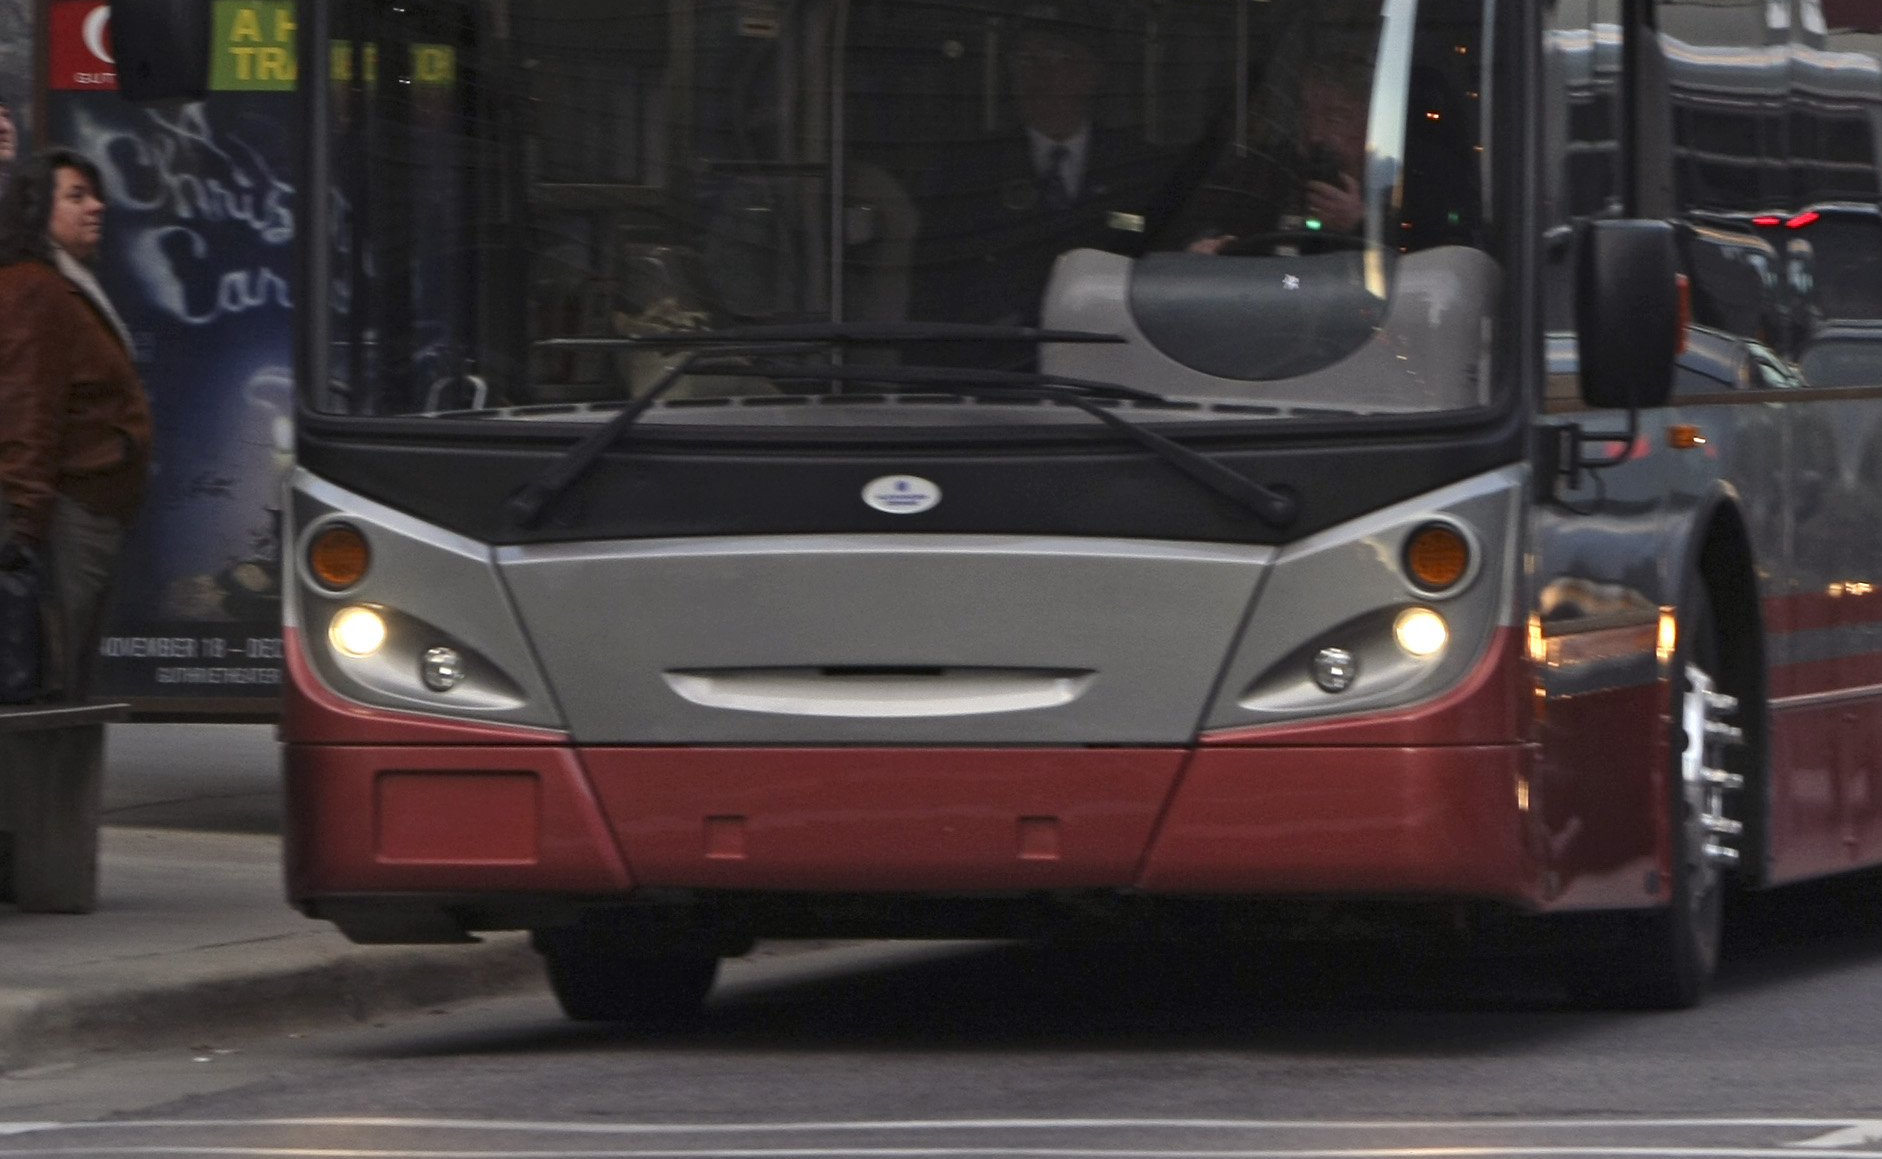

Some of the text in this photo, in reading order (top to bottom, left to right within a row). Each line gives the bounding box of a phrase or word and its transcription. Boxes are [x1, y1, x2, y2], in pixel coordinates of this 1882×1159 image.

[231, 8, 261, 42] A
[228, 46, 298, 80] TR
[80, 107, 295, 243] Chris
[130, 225, 294, 325] Car
